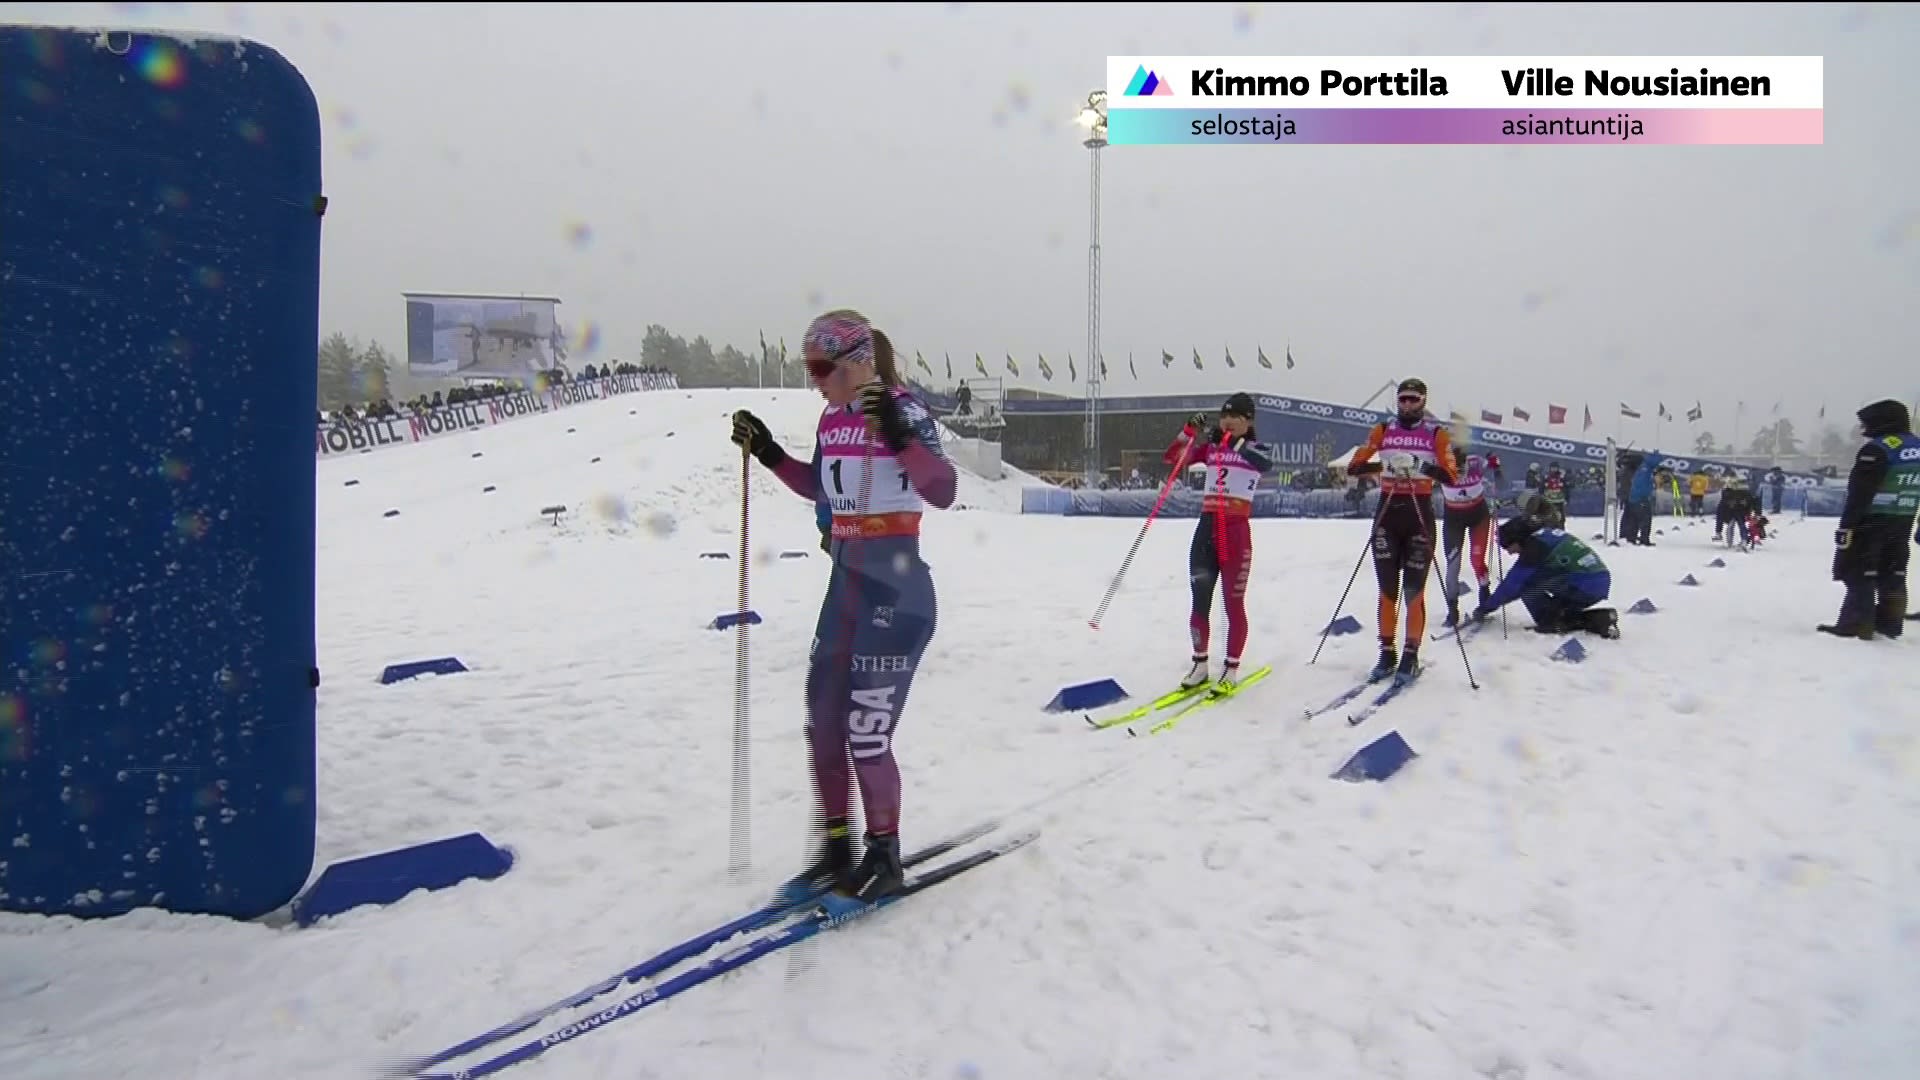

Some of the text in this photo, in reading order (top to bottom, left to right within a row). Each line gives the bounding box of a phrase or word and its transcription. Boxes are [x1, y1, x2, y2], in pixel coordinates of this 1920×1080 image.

[408, 403, 485, 442] MOBILL
[487, 394, 548, 425] MOBILL
[552, 382, 598, 411] MOBILL
[600, 372, 640, 400] MOBILL
[1259, 396, 1292, 411] coop
[1300, 402, 1333, 416] coop
[1343, 408, 1378, 424] coop
[1482, 429, 1521, 446] coop
[1533, 438, 1575, 454] coop
[1585, 446, 1608, 458] co
[1266, 441, 1314, 465] ALUN
[1382, 435, 1433, 450] MOBILL
[829, 459, 844, 495] 1
[898, 471, 910, 491] 1
[1215, 468, 1229, 486] 2
[1247, 479, 1256, 491] 2
[851, 655, 913, 672] STIFEL
[848, 684, 897, 760] USA
[540, 988, 660, 1048] SALOMON
